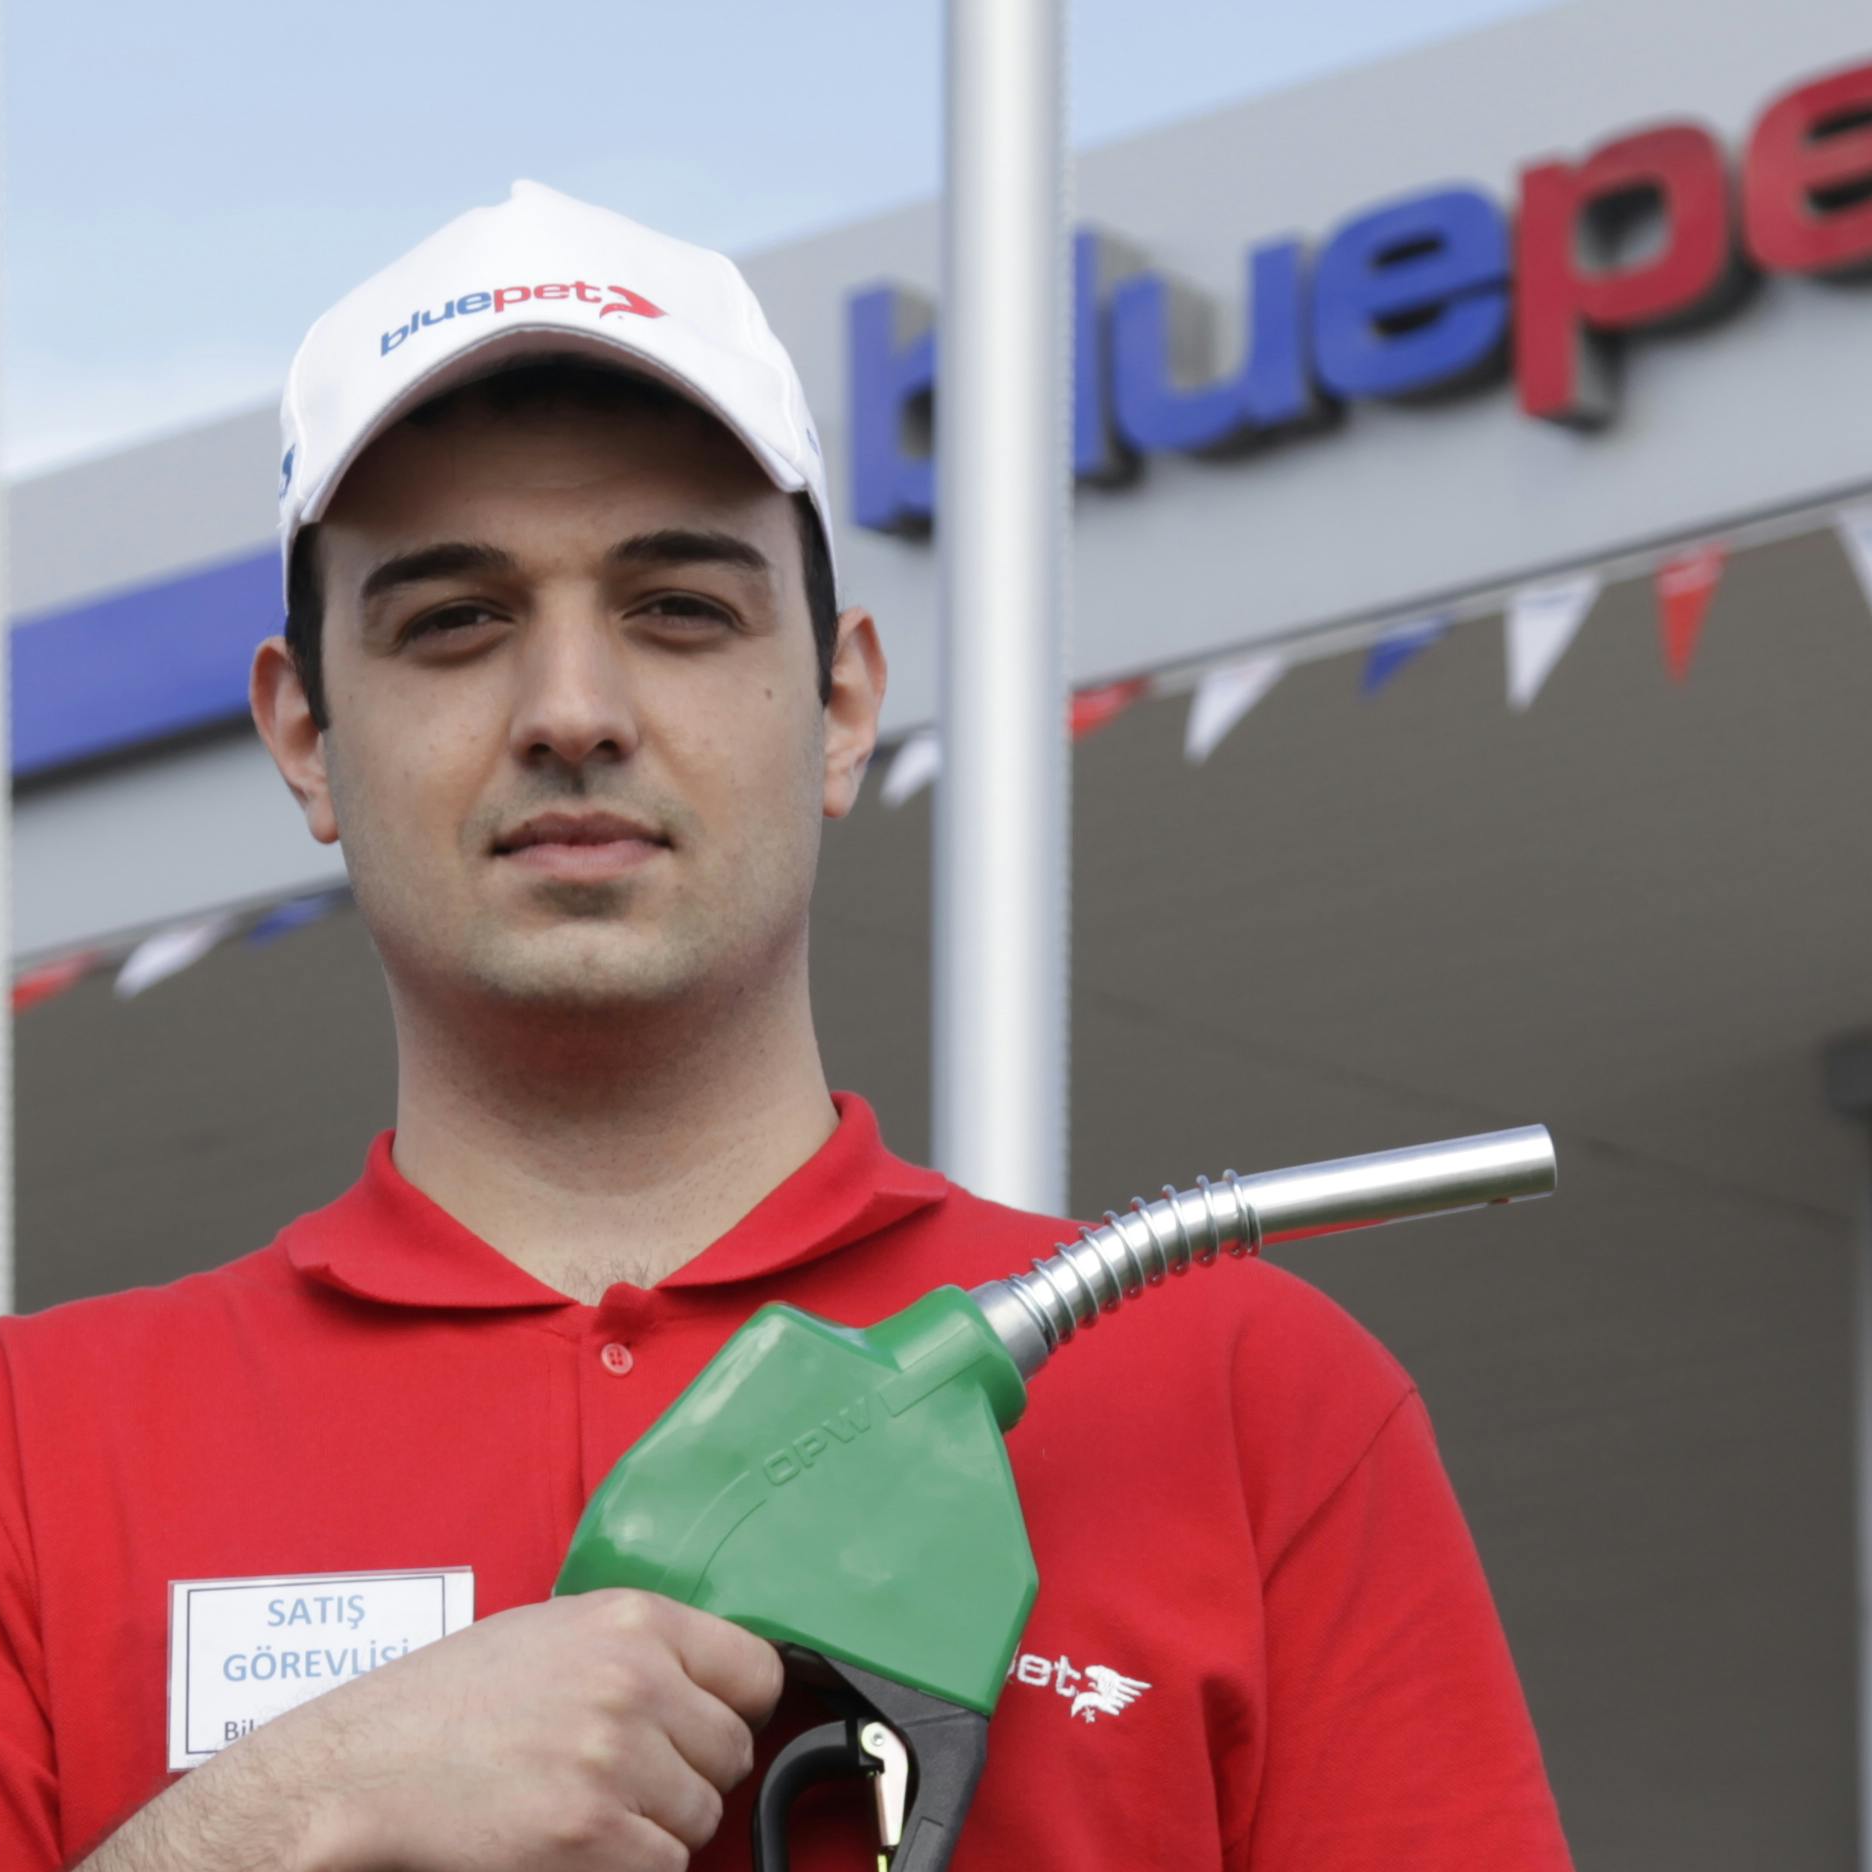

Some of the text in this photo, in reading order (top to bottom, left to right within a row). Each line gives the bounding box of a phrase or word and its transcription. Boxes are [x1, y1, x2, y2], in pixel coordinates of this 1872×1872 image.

[380, 280, 603, 357] bluepet
[761, 1396, 871, 1487] OPW
[267, 1594, 366, 1629] SATIŞ
